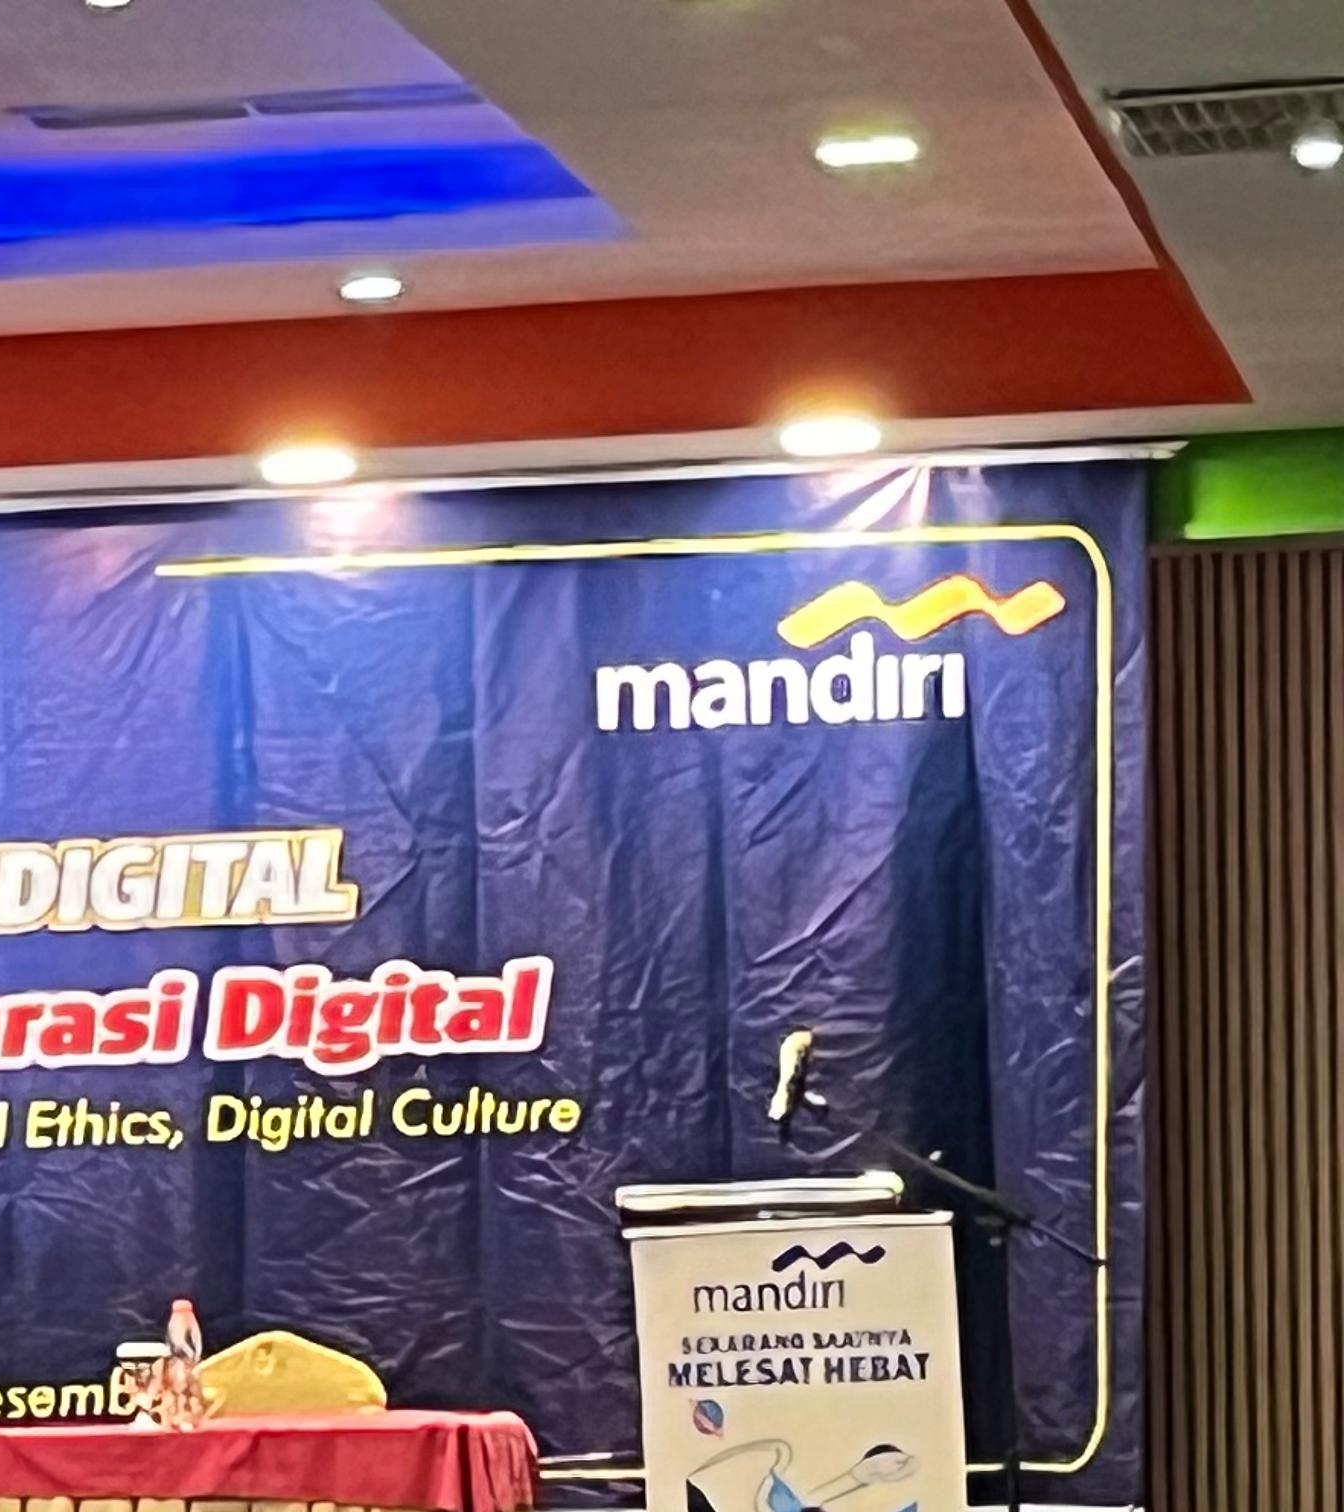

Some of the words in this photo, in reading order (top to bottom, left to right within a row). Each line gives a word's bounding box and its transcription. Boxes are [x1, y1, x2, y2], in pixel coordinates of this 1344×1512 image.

[596, 631, 965, 731] mandiri
[218, 969, 540, 1062] Digital
[25, 1099, 184, 1151] Ethics,
[208, 1098, 372, 1152] Digital
[392, 1087, 581, 1137] Culture
[668, 1357, 814, 1388] MELESAT
[824, 1352, 930, 1384] HEBAT
